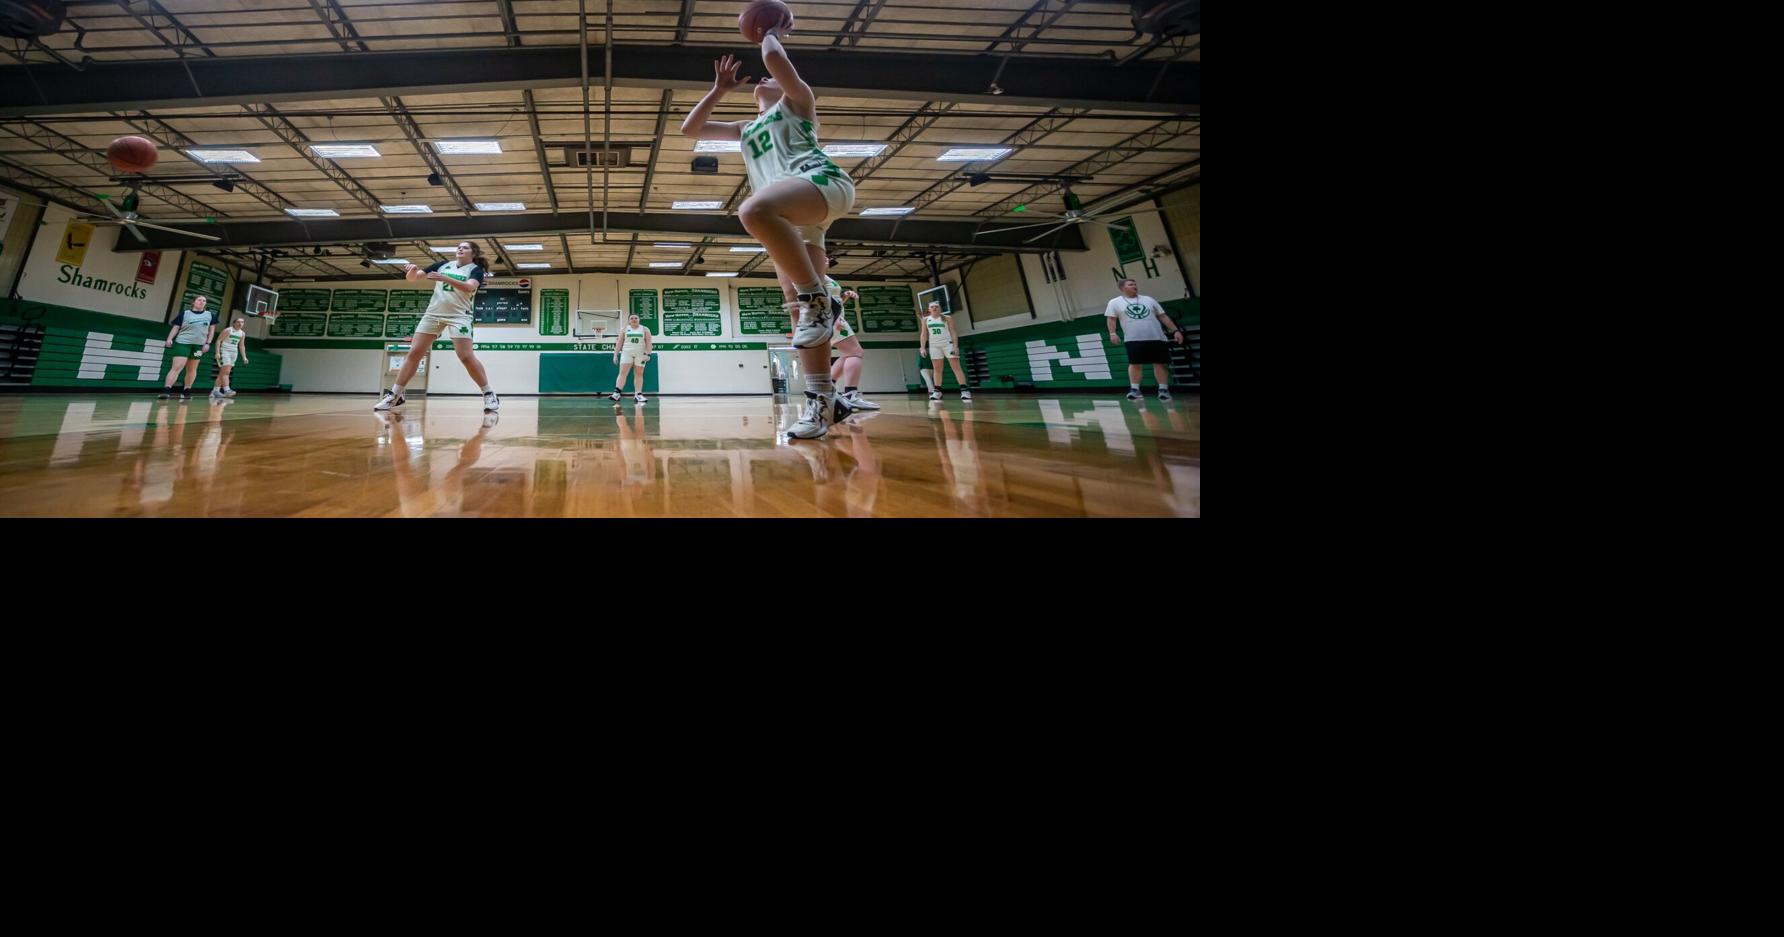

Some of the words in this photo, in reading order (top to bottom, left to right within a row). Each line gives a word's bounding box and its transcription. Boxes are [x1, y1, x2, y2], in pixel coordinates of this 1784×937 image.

[747, 130, 773, 160] 12
[57, 264, 147, 299] Shamrocks
[1111, 265, 1127, 282] N
[1142, 258, 1160, 279] H
